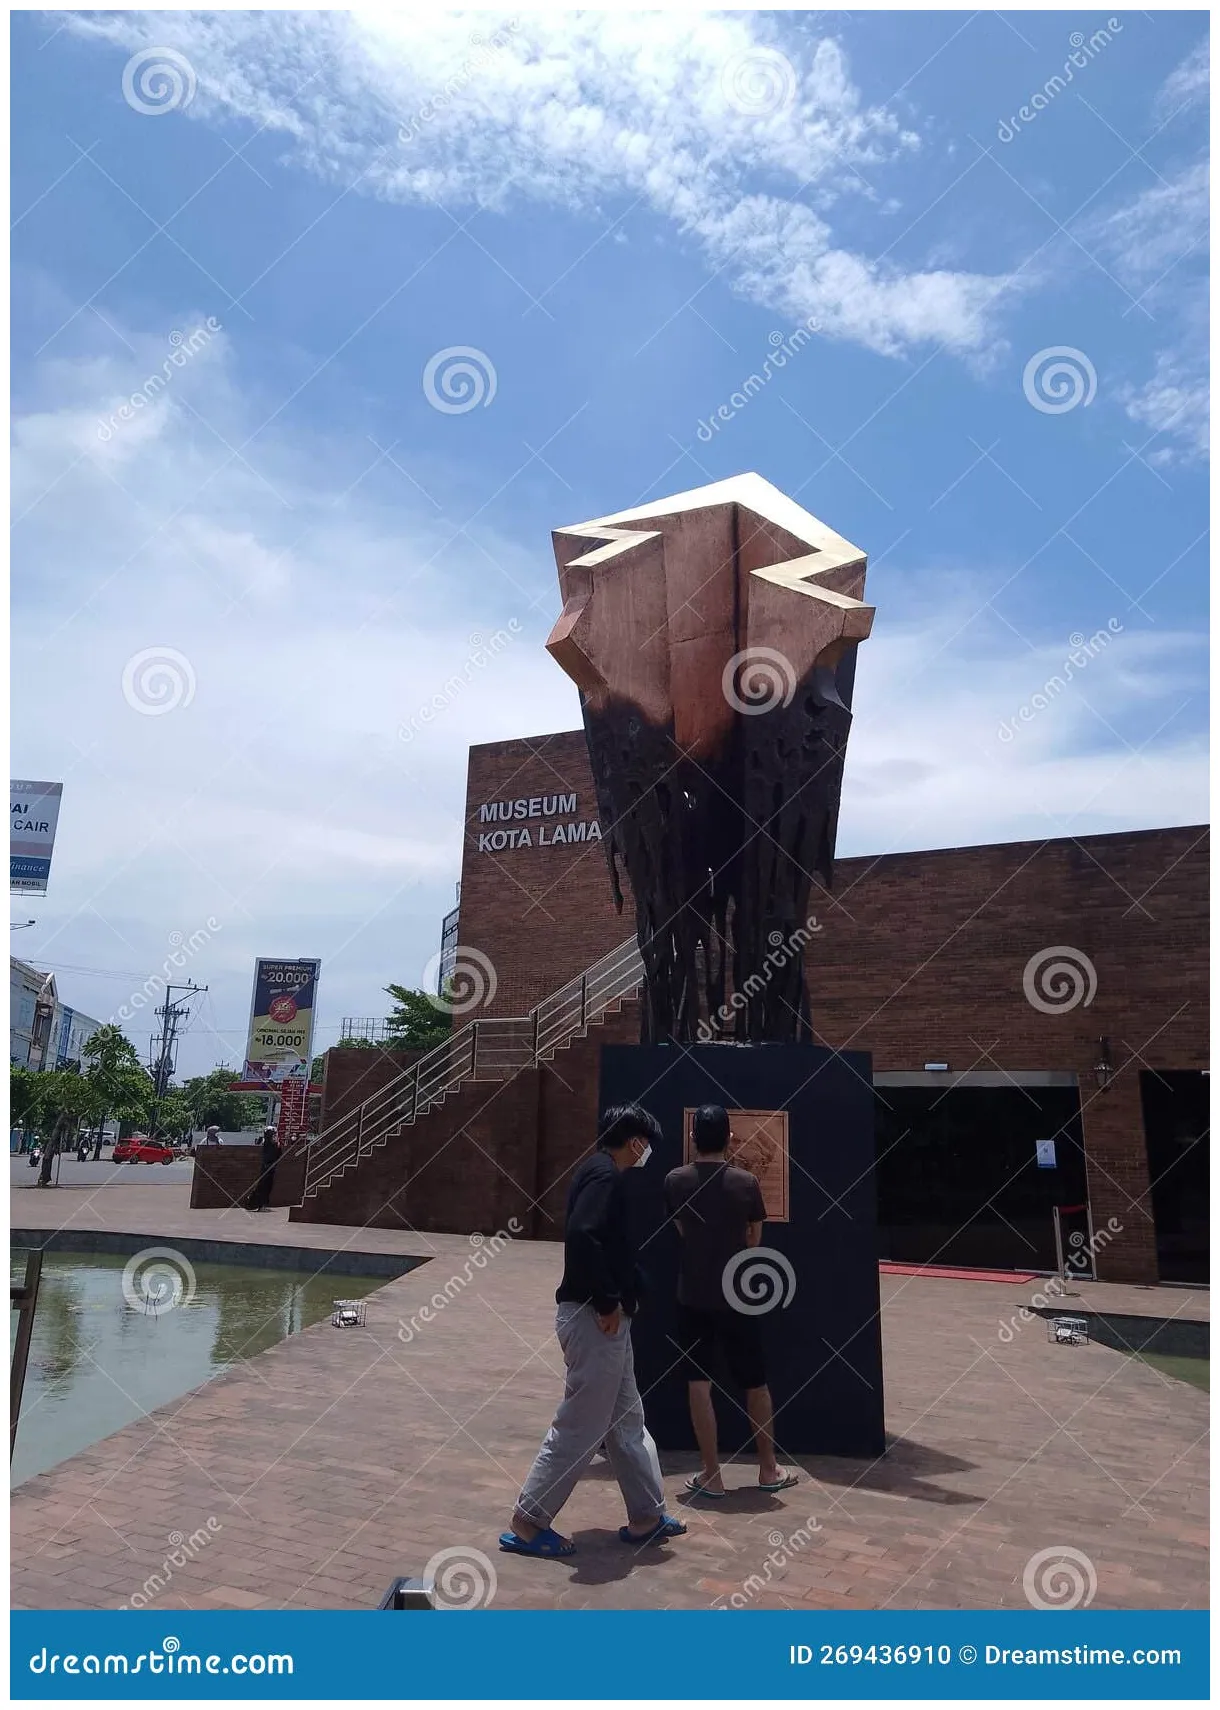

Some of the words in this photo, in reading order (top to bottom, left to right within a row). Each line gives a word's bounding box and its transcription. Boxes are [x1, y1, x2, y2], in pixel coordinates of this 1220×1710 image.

[10, 803, 29, 814] AI
[480, 793, 577, 823] MUSEUM
[13, 820, 49, 833] CAIR
[479, 828, 533, 852] KOTA
[538, 820, 603, 846] LAMA
